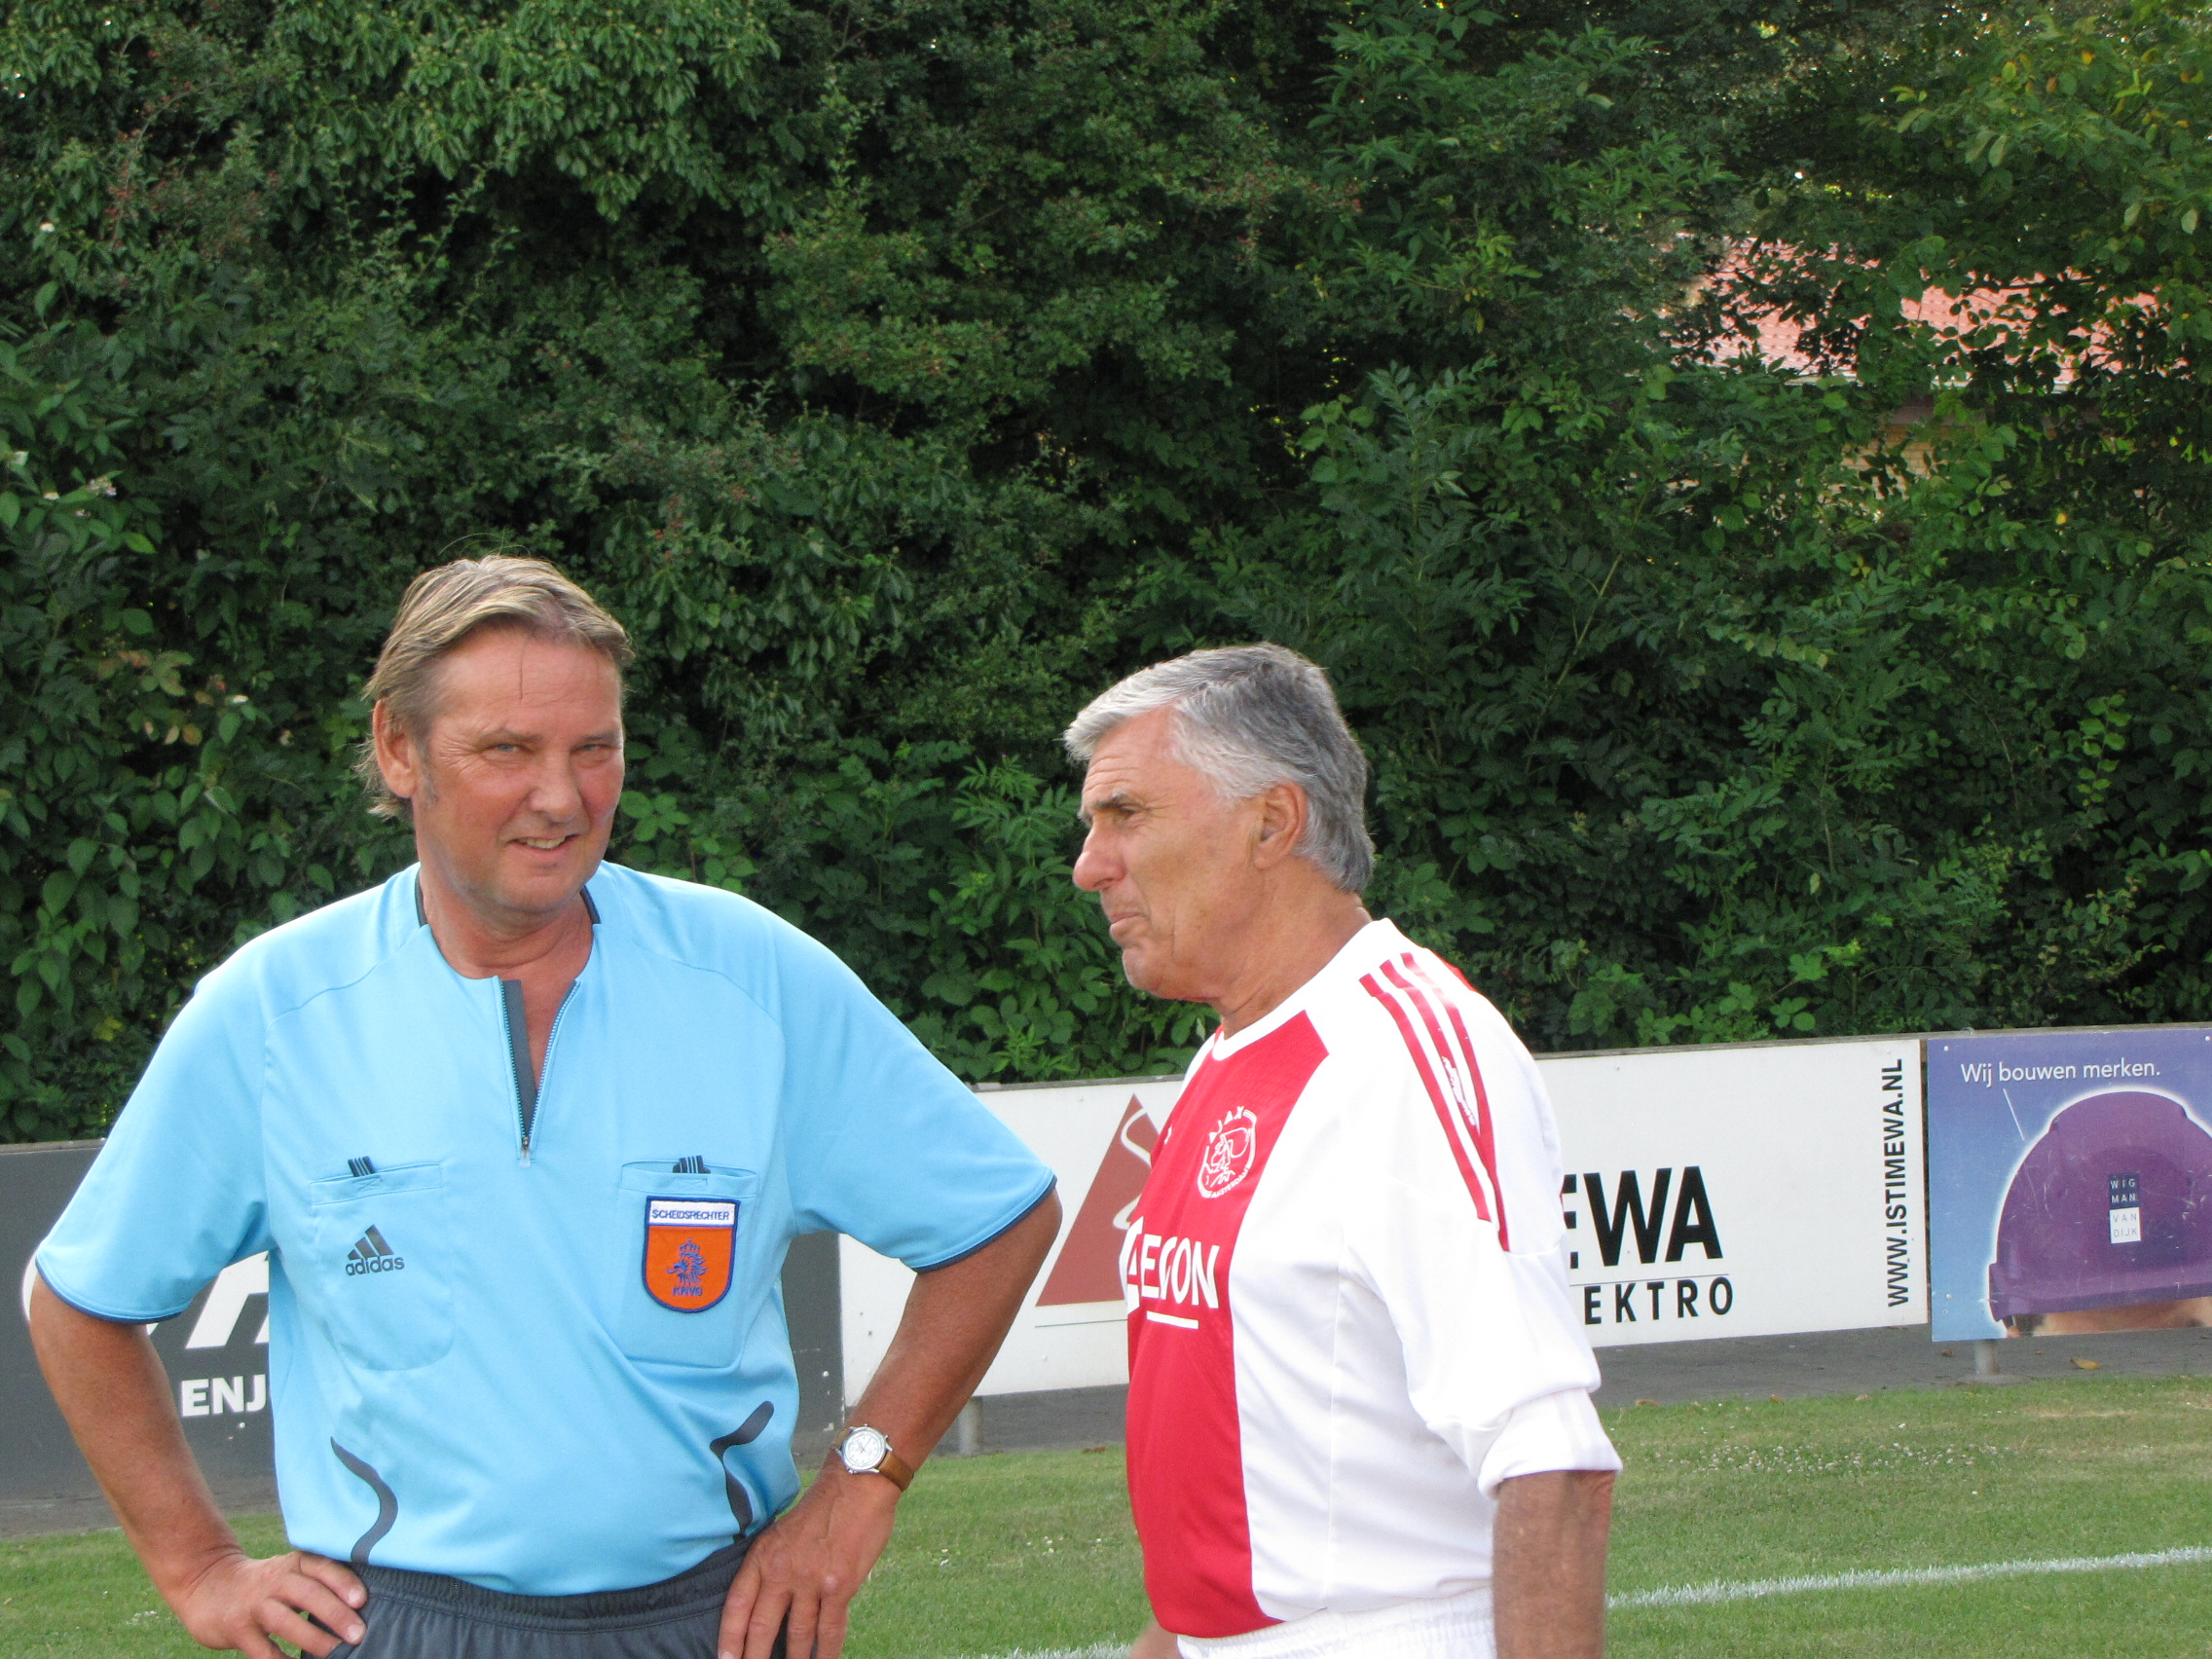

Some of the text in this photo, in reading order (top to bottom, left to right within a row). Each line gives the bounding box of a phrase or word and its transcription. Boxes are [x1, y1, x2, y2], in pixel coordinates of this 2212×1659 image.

[1960, 1056, 2161, 1088] Wij bouwen merken.
[1208, 1105, 1245, 1145] AJAX
[1209, 1167, 1250, 1199] AMSTERDAM
[1881, 1058, 1909, 1309] WWW.ISTIMEWA.NL
[2110, 1177, 2136, 1190] WIG
[2111, 1193, 2137, 1204] MAN
[651, 1209, 730, 1221] SCHEIDSRECHTER
[2112, 1212, 2137, 1223] VAN
[345, 1256, 406, 1276] adidas
[1583, 1275, 1734, 1326] EKTRO
[180, 1374, 267, 1418] ENJ
